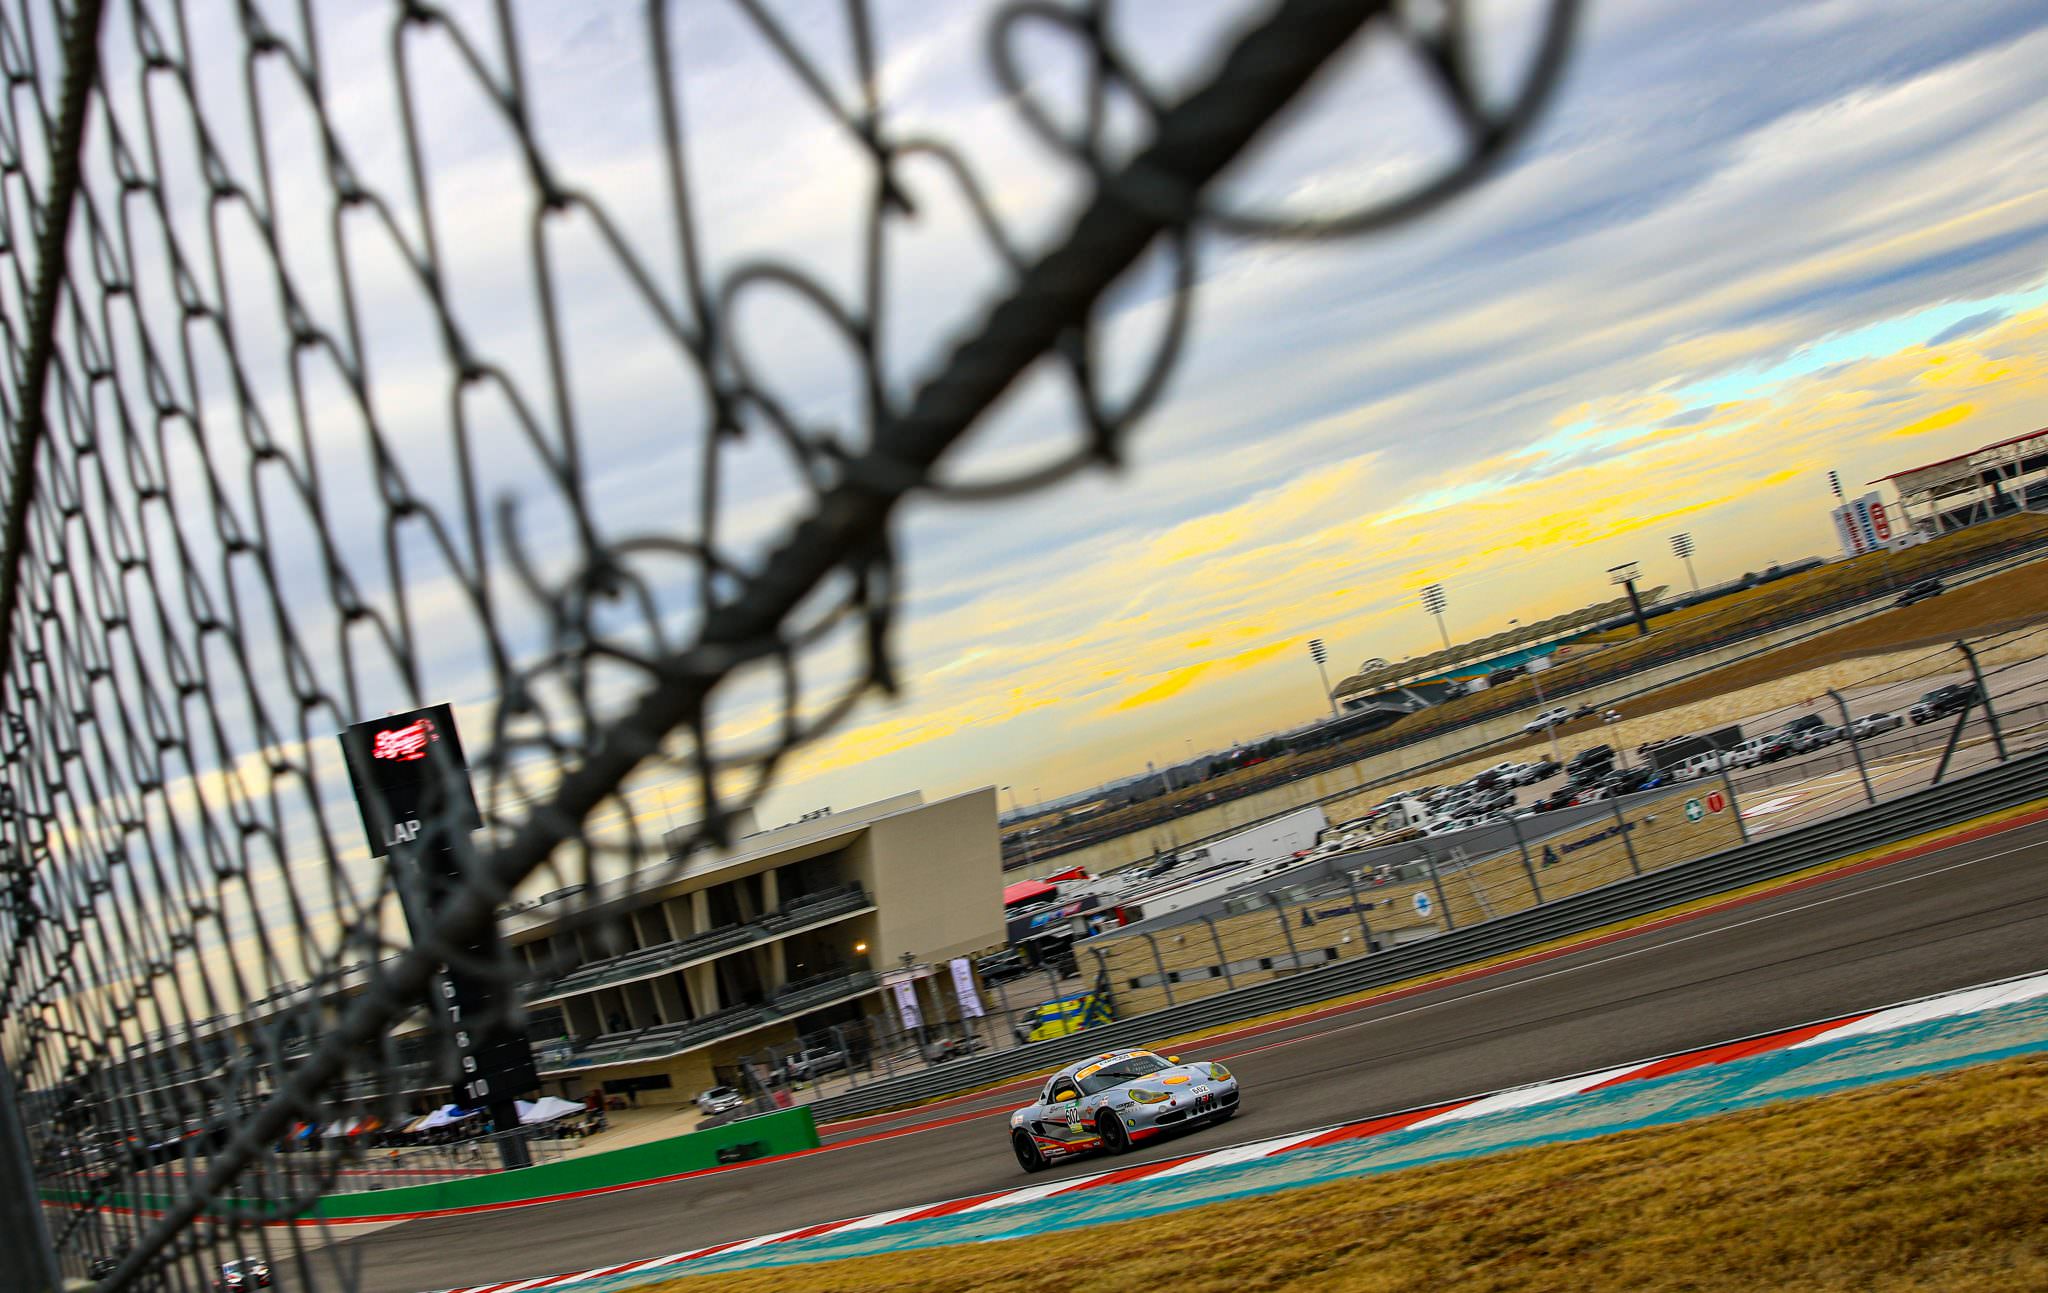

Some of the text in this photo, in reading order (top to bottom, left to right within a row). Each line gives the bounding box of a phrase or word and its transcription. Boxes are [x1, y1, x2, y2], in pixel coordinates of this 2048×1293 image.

[441, 981, 456, 999] 6
[447, 1005, 460, 1023] 7
[455, 1031, 470, 1048] 8
[462, 1056, 477, 1073] 9
[464, 1079, 489, 1099] 10
[1191, 1085, 1208, 1095] 602
[1065, 1107, 1081, 1125] 602
